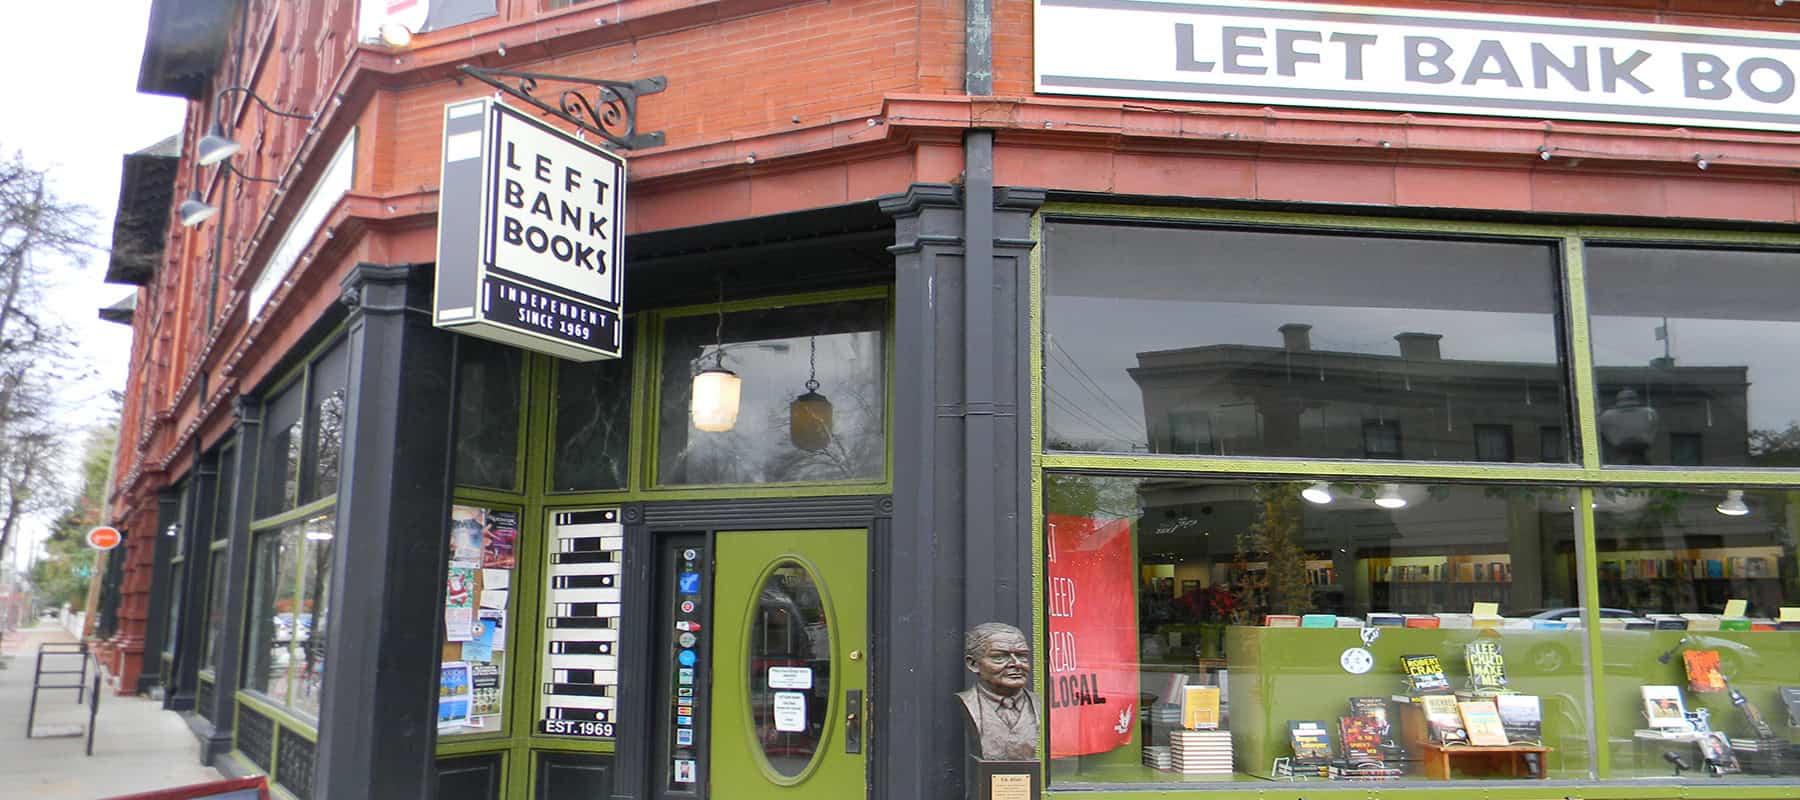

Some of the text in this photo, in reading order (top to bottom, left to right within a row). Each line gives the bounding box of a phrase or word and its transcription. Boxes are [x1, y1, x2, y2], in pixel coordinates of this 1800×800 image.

[1174, 22, 1796, 105] LEFT BANK BO
[506, 141, 609, 205] LEFT
[504, 178, 608, 240] BANK
[503, 216, 608, 275] BOOKS
[499, 285, 608, 328] INDEPENDENT
[517, 307, 590, 340] SINCE 1969
[1048, 576, 1075, 617] LEEP
[1048, 631, 1077, 673] READ
[1407, 657, 1441, 668] ROBERT
[1470, 654, 1504, 665] CHILD
[1475, 643, 1495, 653] LEE
[1409, 665, 1444, 676] CRAIS
[1473, 664, 1504, 676] MAKE
[1481, 675, 1499, 686] ME
[1049, 672, 1107, 709] LOCAL
[545, 720, 613, 737] EST.1969
